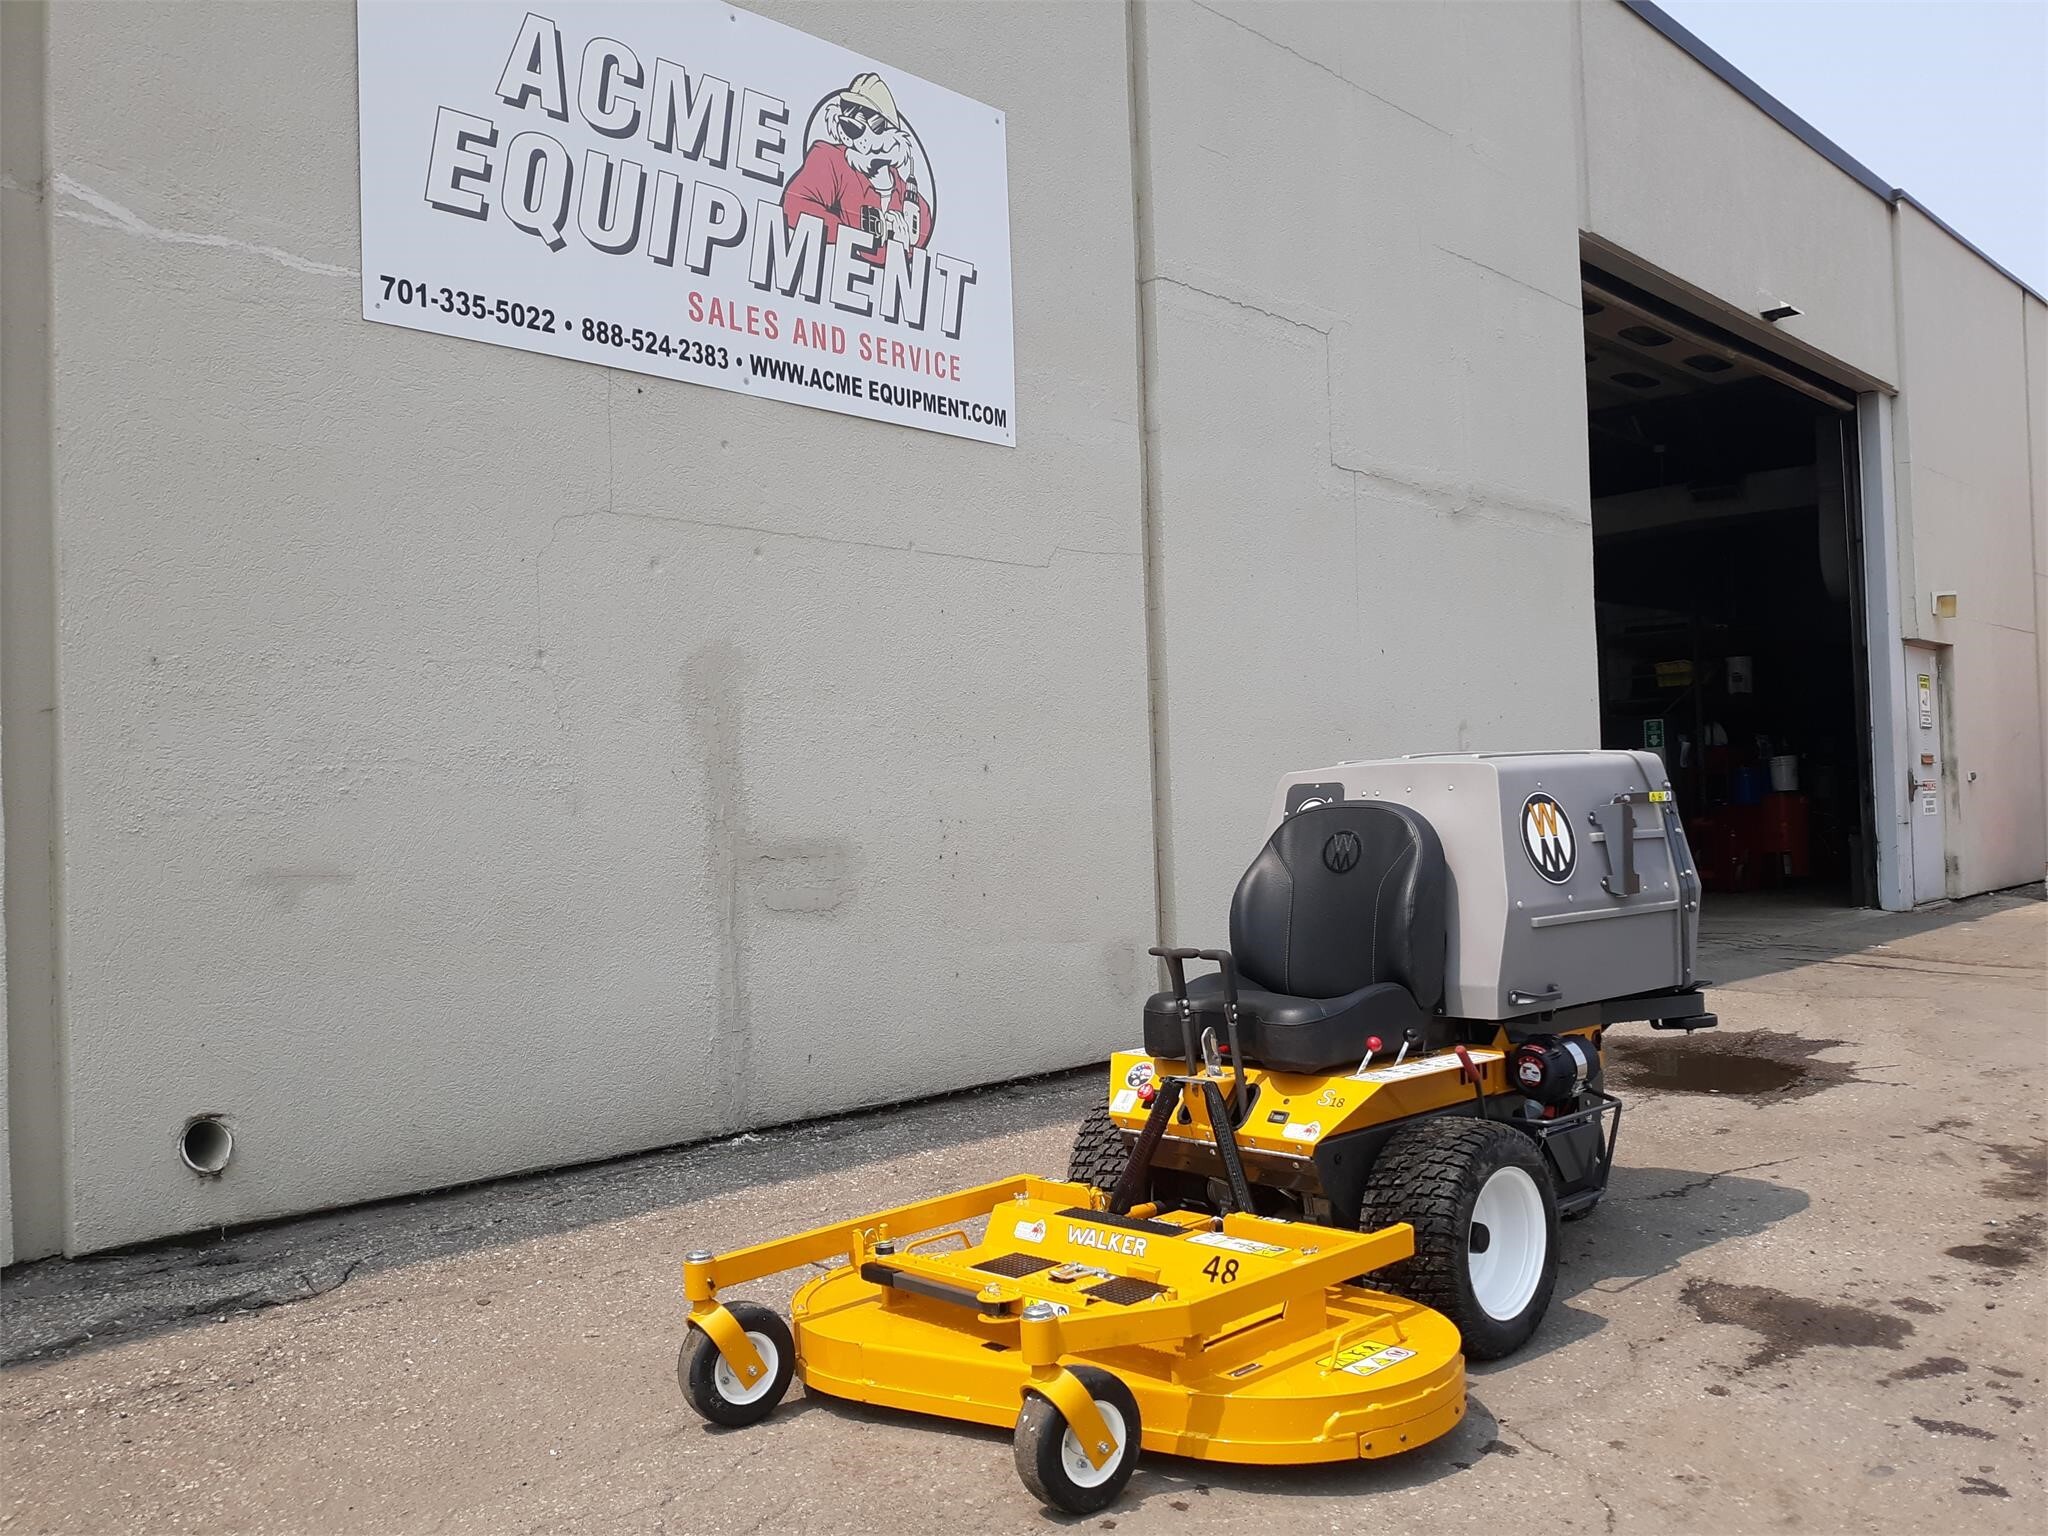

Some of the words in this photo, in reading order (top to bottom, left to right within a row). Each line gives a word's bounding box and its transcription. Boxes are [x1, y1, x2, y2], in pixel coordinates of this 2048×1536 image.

[497, 12, 790, 187] ACME
[424, 105, 978, 341] EQUIPMENT
[379, 274, 556, 333] 701-335-5022
[581, 317, 730, 370] 888-524-2383
[750, 354, 863, 398] WWW.ACME
[868, 380, 1007, 428] EQUIPMENT.COM
[688, 291, 780, 340] SALES
[792, 317, 847, 355] AND
[859, 332, 961, 382] SERVICE
[1067, 1224, 1147, 1258] WALKER
[1202, 1255, 1240, 1285] 48
